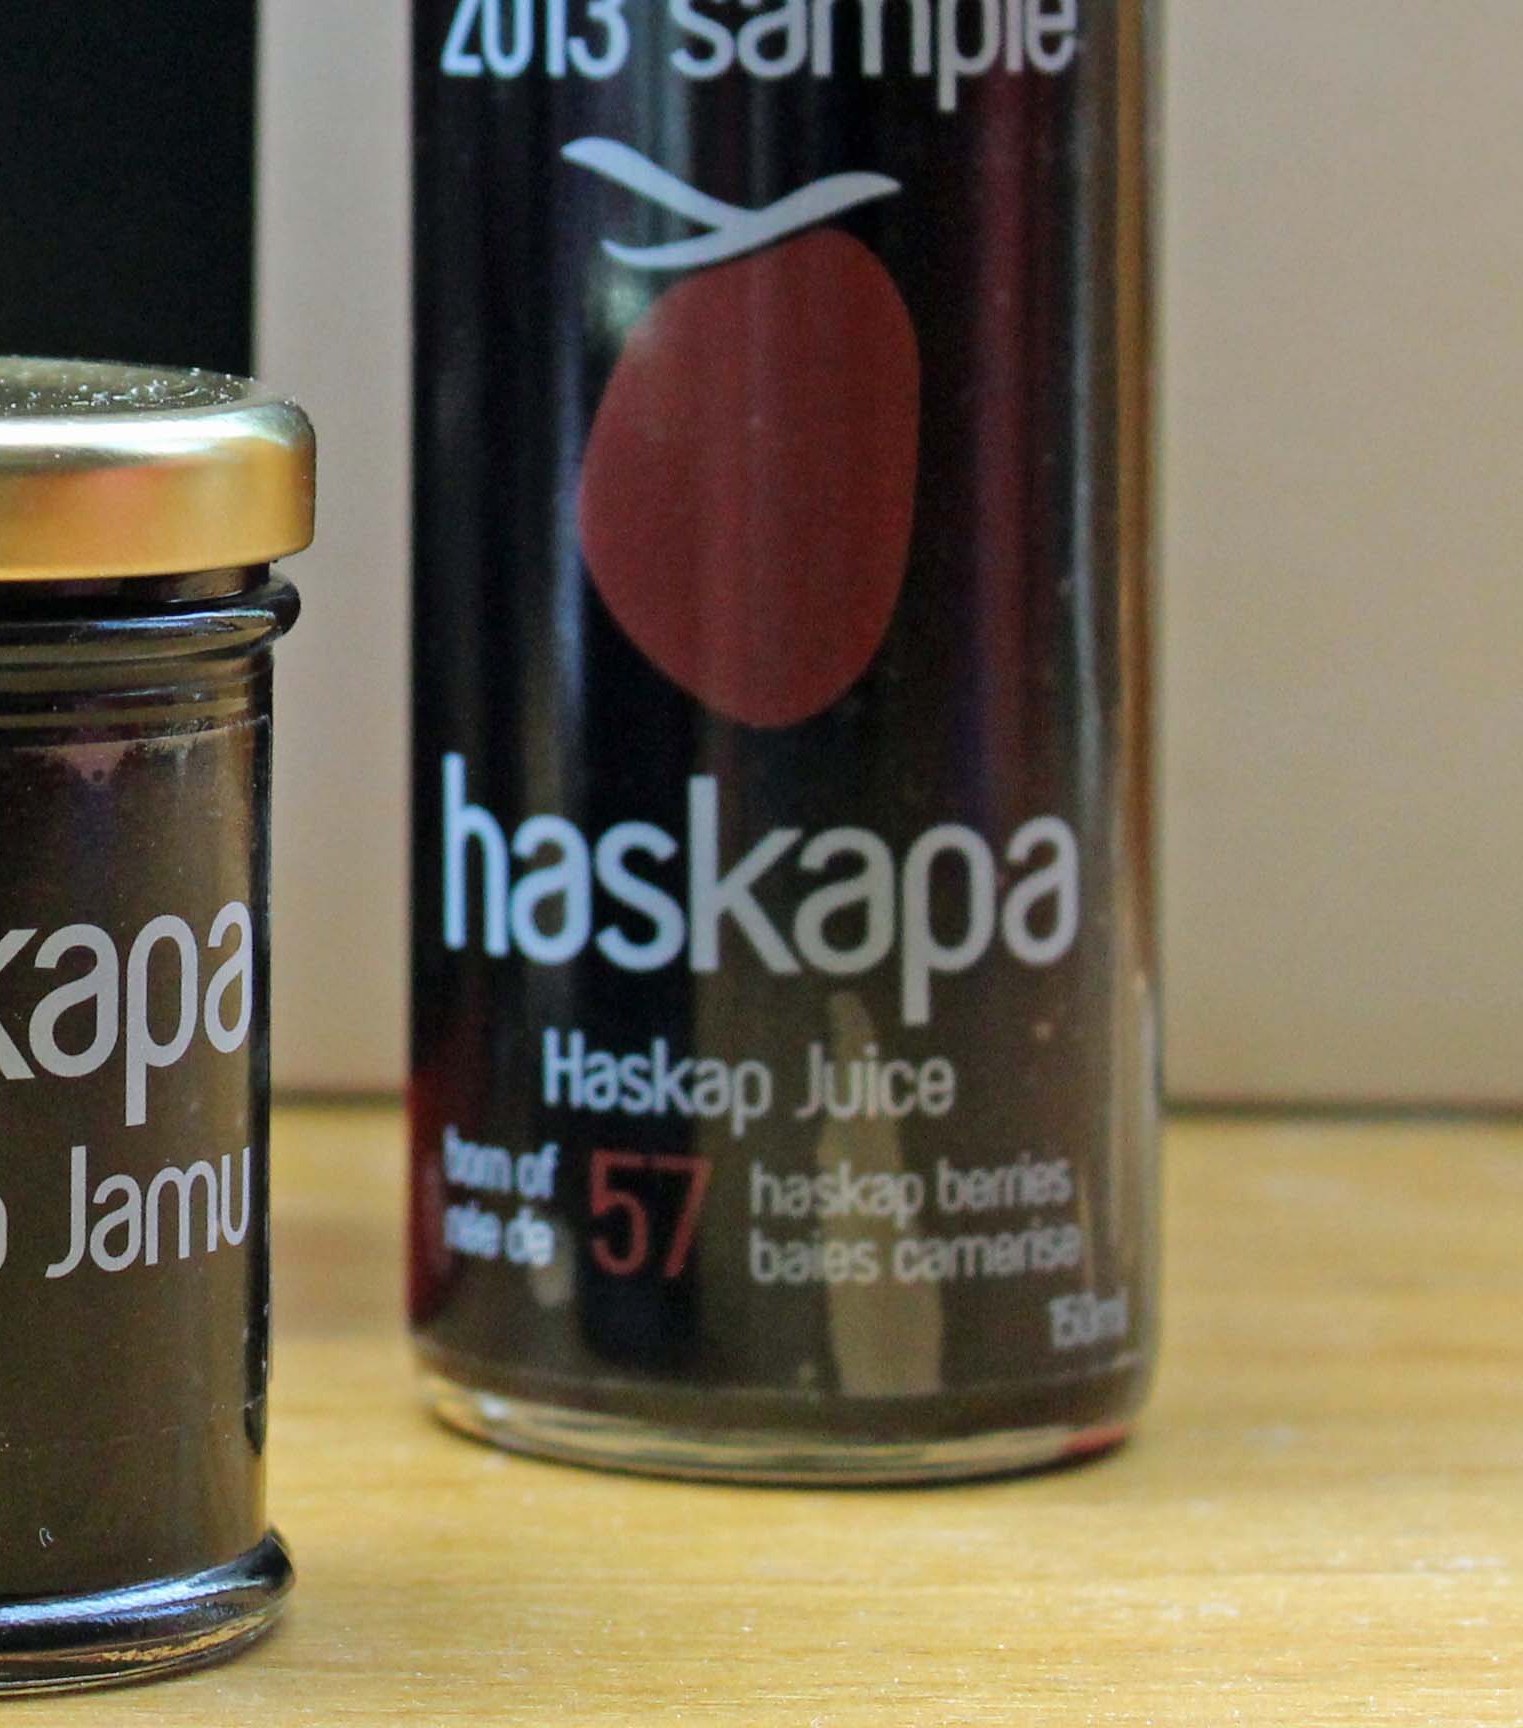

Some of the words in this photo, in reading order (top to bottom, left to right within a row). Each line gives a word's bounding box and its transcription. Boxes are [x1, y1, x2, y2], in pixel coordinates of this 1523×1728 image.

[442, 752, 1079, 1026] haskapa
[542, 1026, 773, 1138] Haskap
[795, 1042, 956, 1120] Juice
[590, 1148, 713, 1278] 57
[751, 1160, 925, 1232] haskap
[937, 1152, 1073, 1212] berries
[750, 1226, 880, 1286] baies
